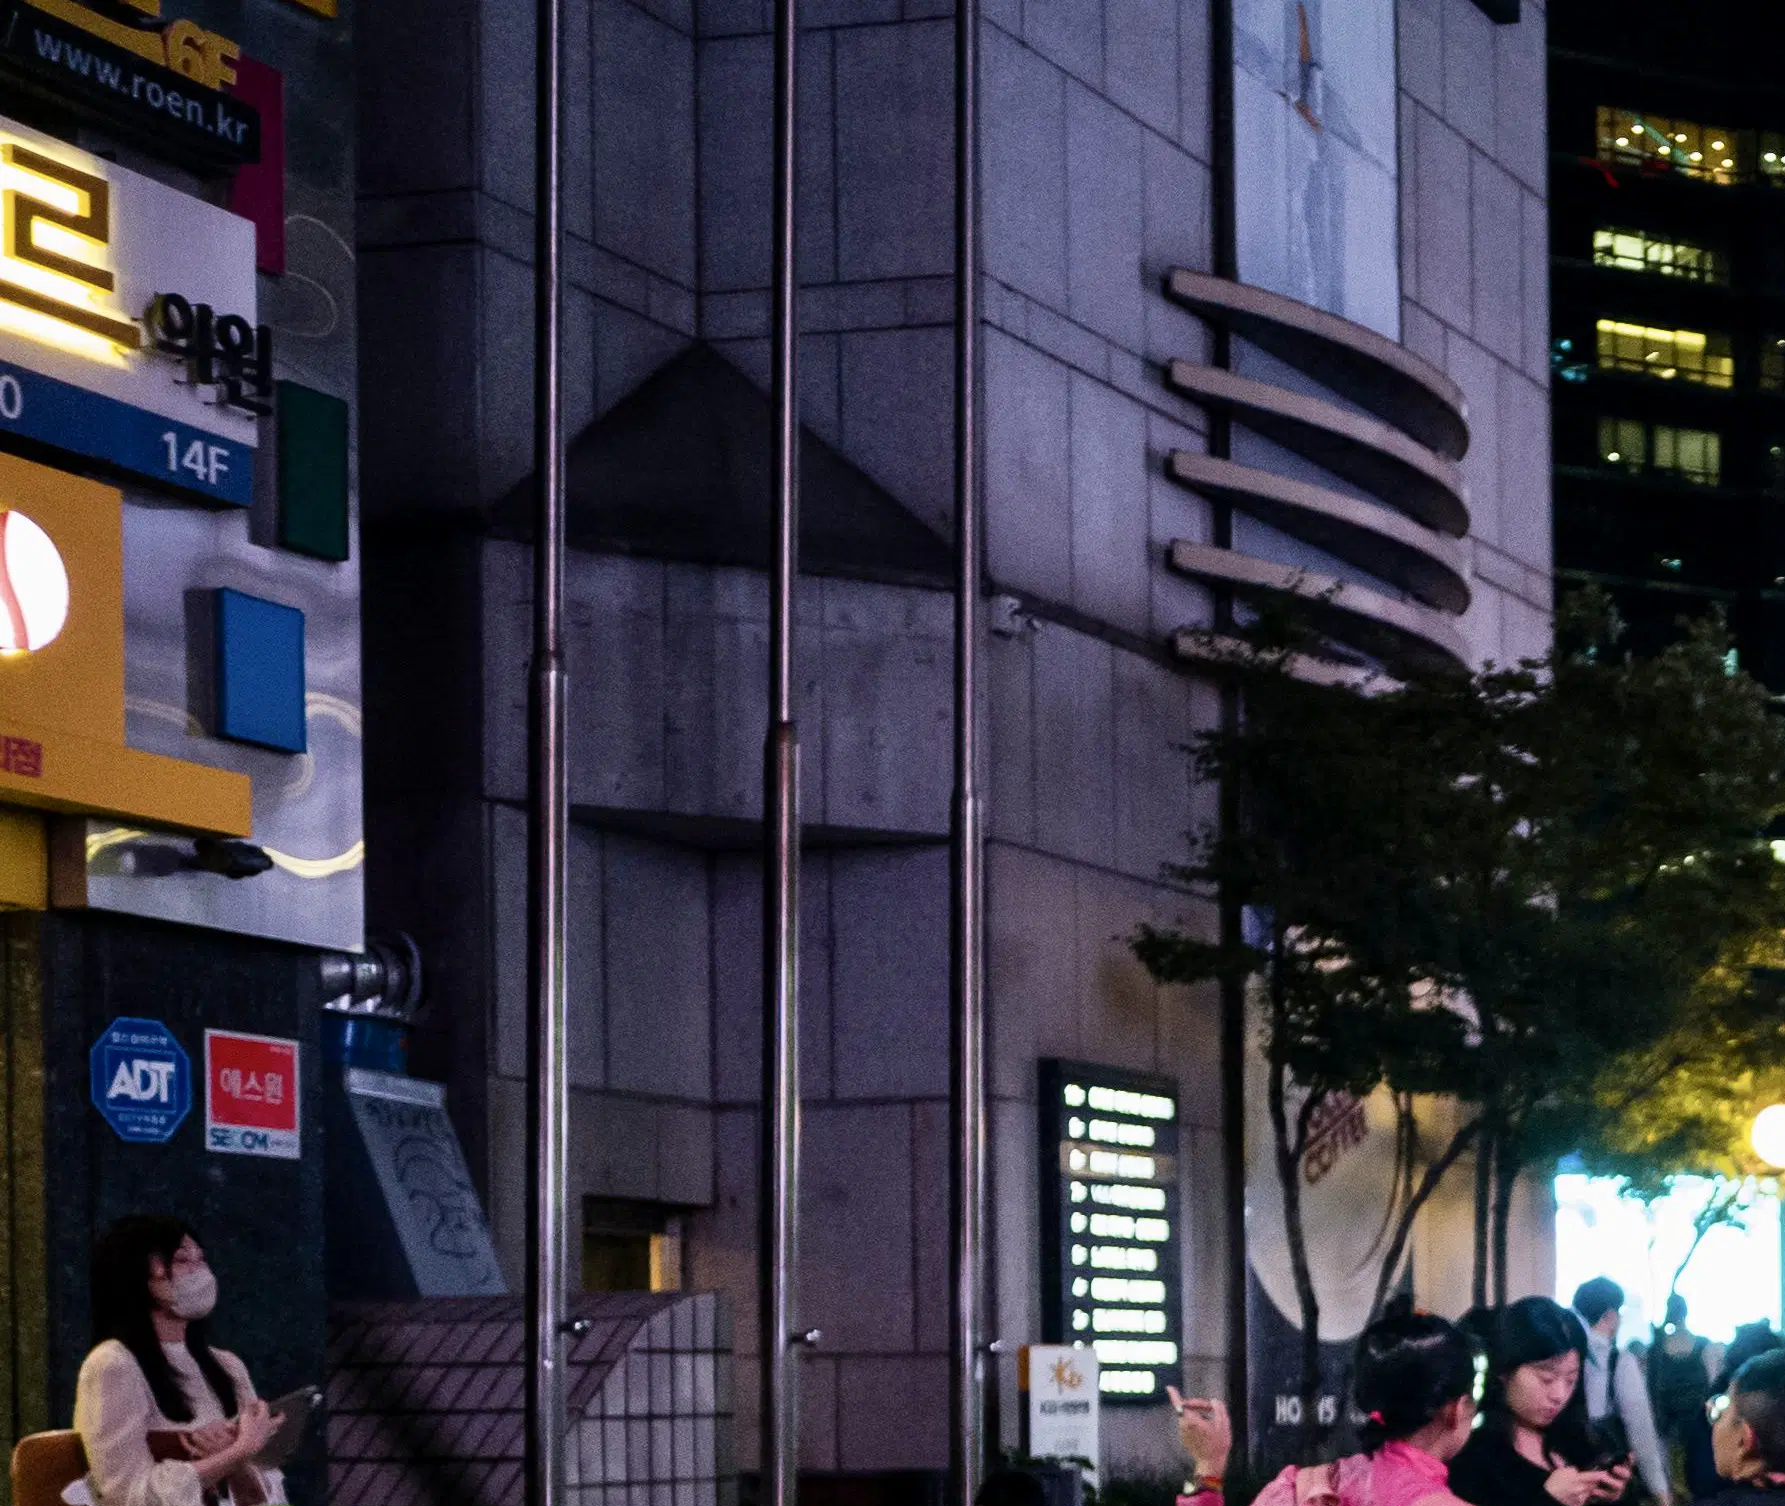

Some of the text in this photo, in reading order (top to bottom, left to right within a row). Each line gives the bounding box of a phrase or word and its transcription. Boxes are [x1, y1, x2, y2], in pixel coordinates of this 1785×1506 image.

[163, 18, 241, 91] 6F
[34, 28, 249, 145] www.roen.kr
[161, 430, 230, 486] 14F
[106, 1059, 176, 1104] ADT
[219, 1067, 284, 1105] 에스원
